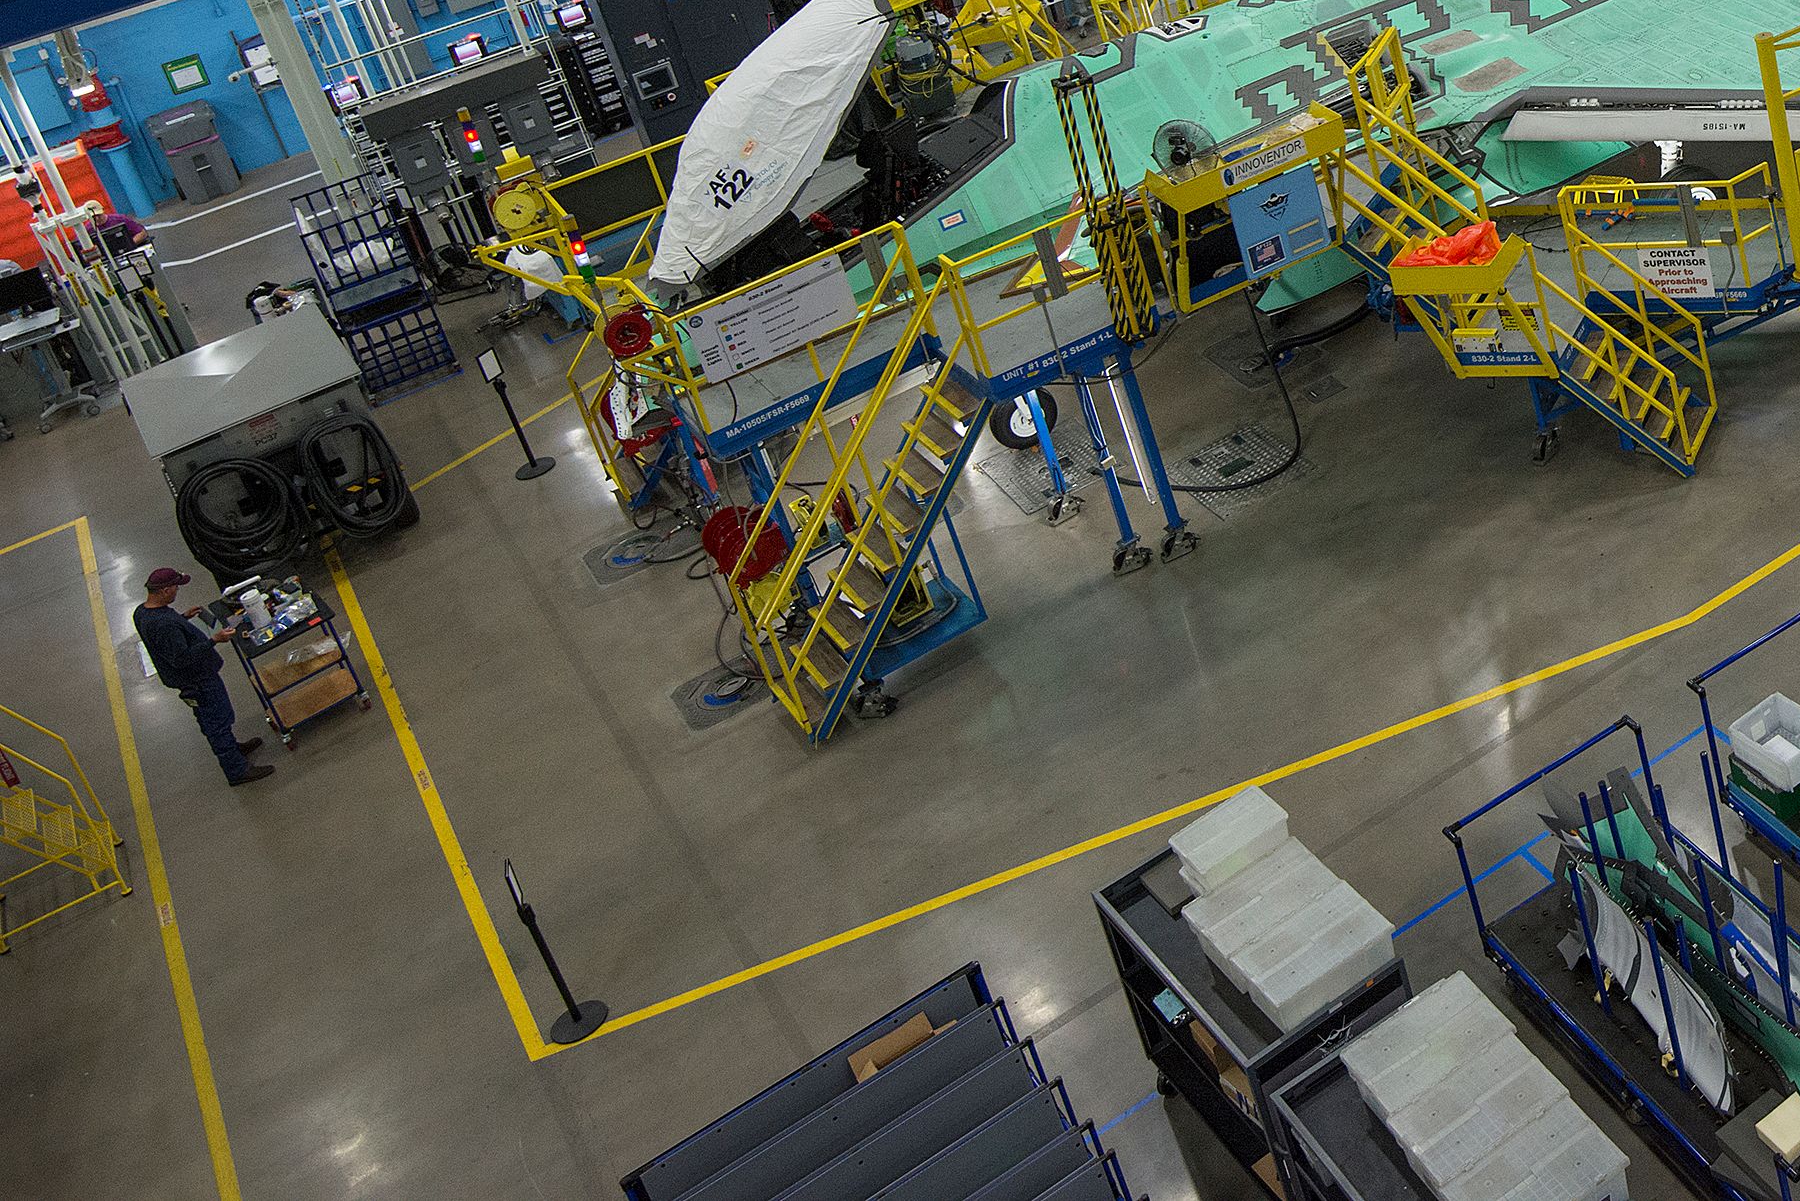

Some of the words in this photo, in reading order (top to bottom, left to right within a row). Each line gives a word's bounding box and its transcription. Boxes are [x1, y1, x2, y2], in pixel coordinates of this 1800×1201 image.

[1703, 123, 1746, 131] MA-15185
[709, 169, 728, 194] AF
[714, 169, 754, 210] 122
[1649, 249, 1696, 258] CONTACT
[1643, 258, 1706, 268] SUPERVISOR
[1658, 268, 1679, 277] Prior
[1681, 268, 1694, 276] to
[764, 283, 783, 294] Stands
[735, 309, 749, 317] Color
[730, 318, 748, 328] YELLOW
[733, 330, 745, 338] BLUE
[1070, 338, 1097, 357] Stand
[1098, 331, 1113, 347] 1-L
[701, 344, 719, 355] Aircraft
[745, 356, 760, 366] GREEN
[1471, 354, 1494, 363] 830-2
[1496, 353, 1519, 362] Stand
[1521, 353, 1537, 362] 2-L
[1002, 366, 1026, 383] UNIT
[1028, 360, 1039, 372] #1
[725, 394, 810, 440] MA-10505/FSR-F5669
